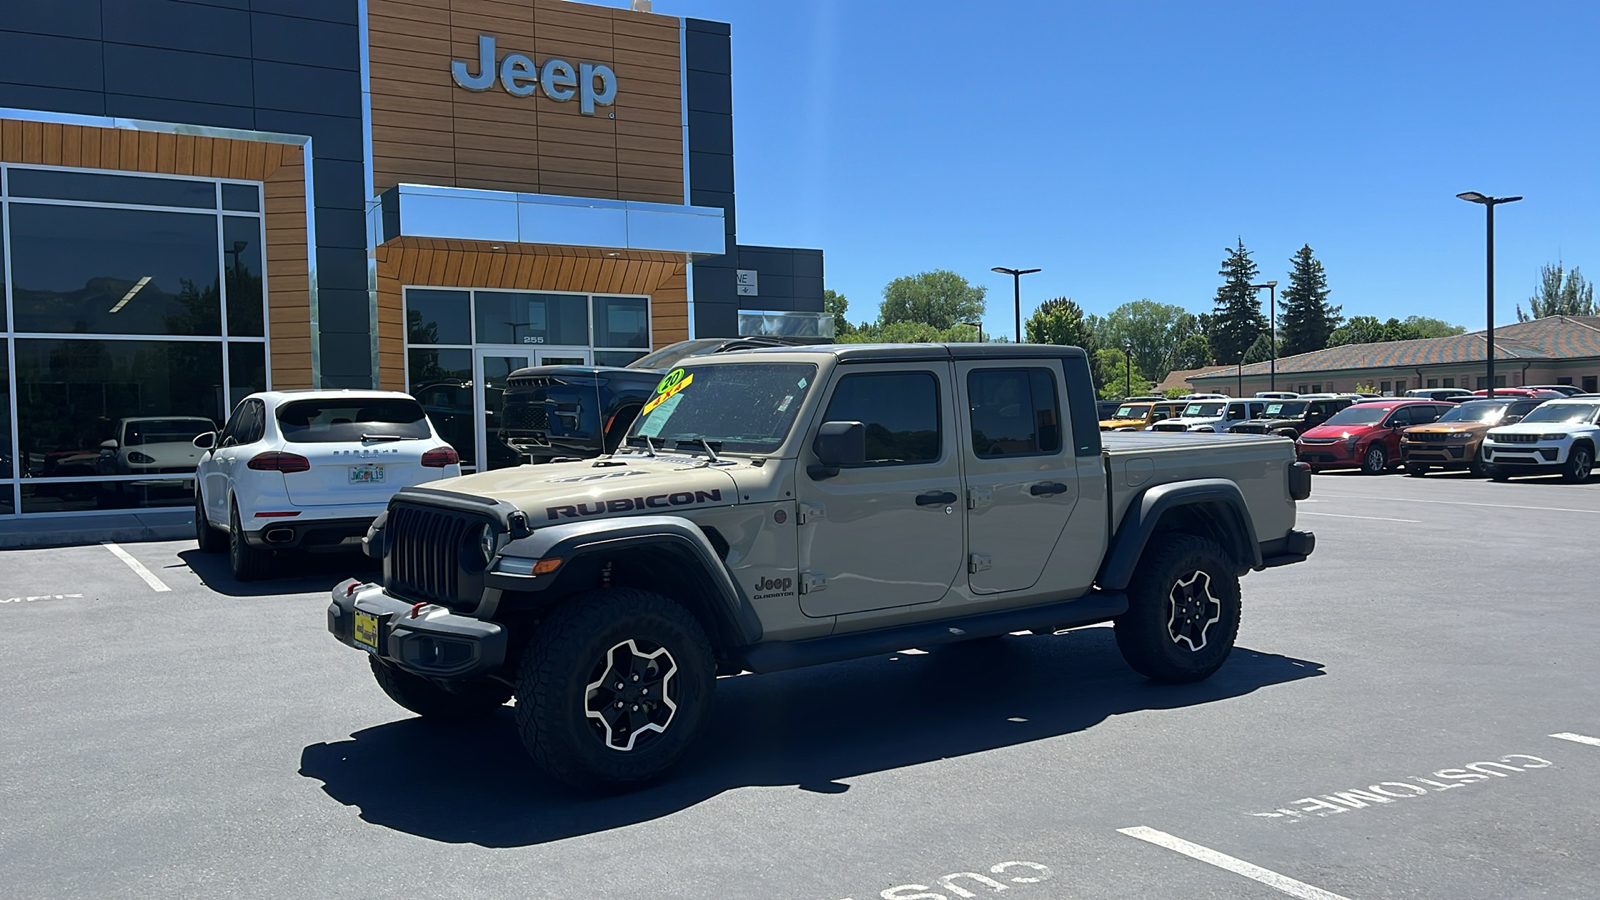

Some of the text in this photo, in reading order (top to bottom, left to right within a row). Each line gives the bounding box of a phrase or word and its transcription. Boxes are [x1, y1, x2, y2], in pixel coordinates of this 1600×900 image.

[451, 34, 617, 116] Jeep
[523, 336, 544, 344] 255
[661, 371, 681, 391] 20
[546, 489, 722, 520] RUBICON
[755, 576, 792, 591] Jeep
[753, 591, 794, 600] GLADIATOR
[840, 861, 1051, 900] CUS
